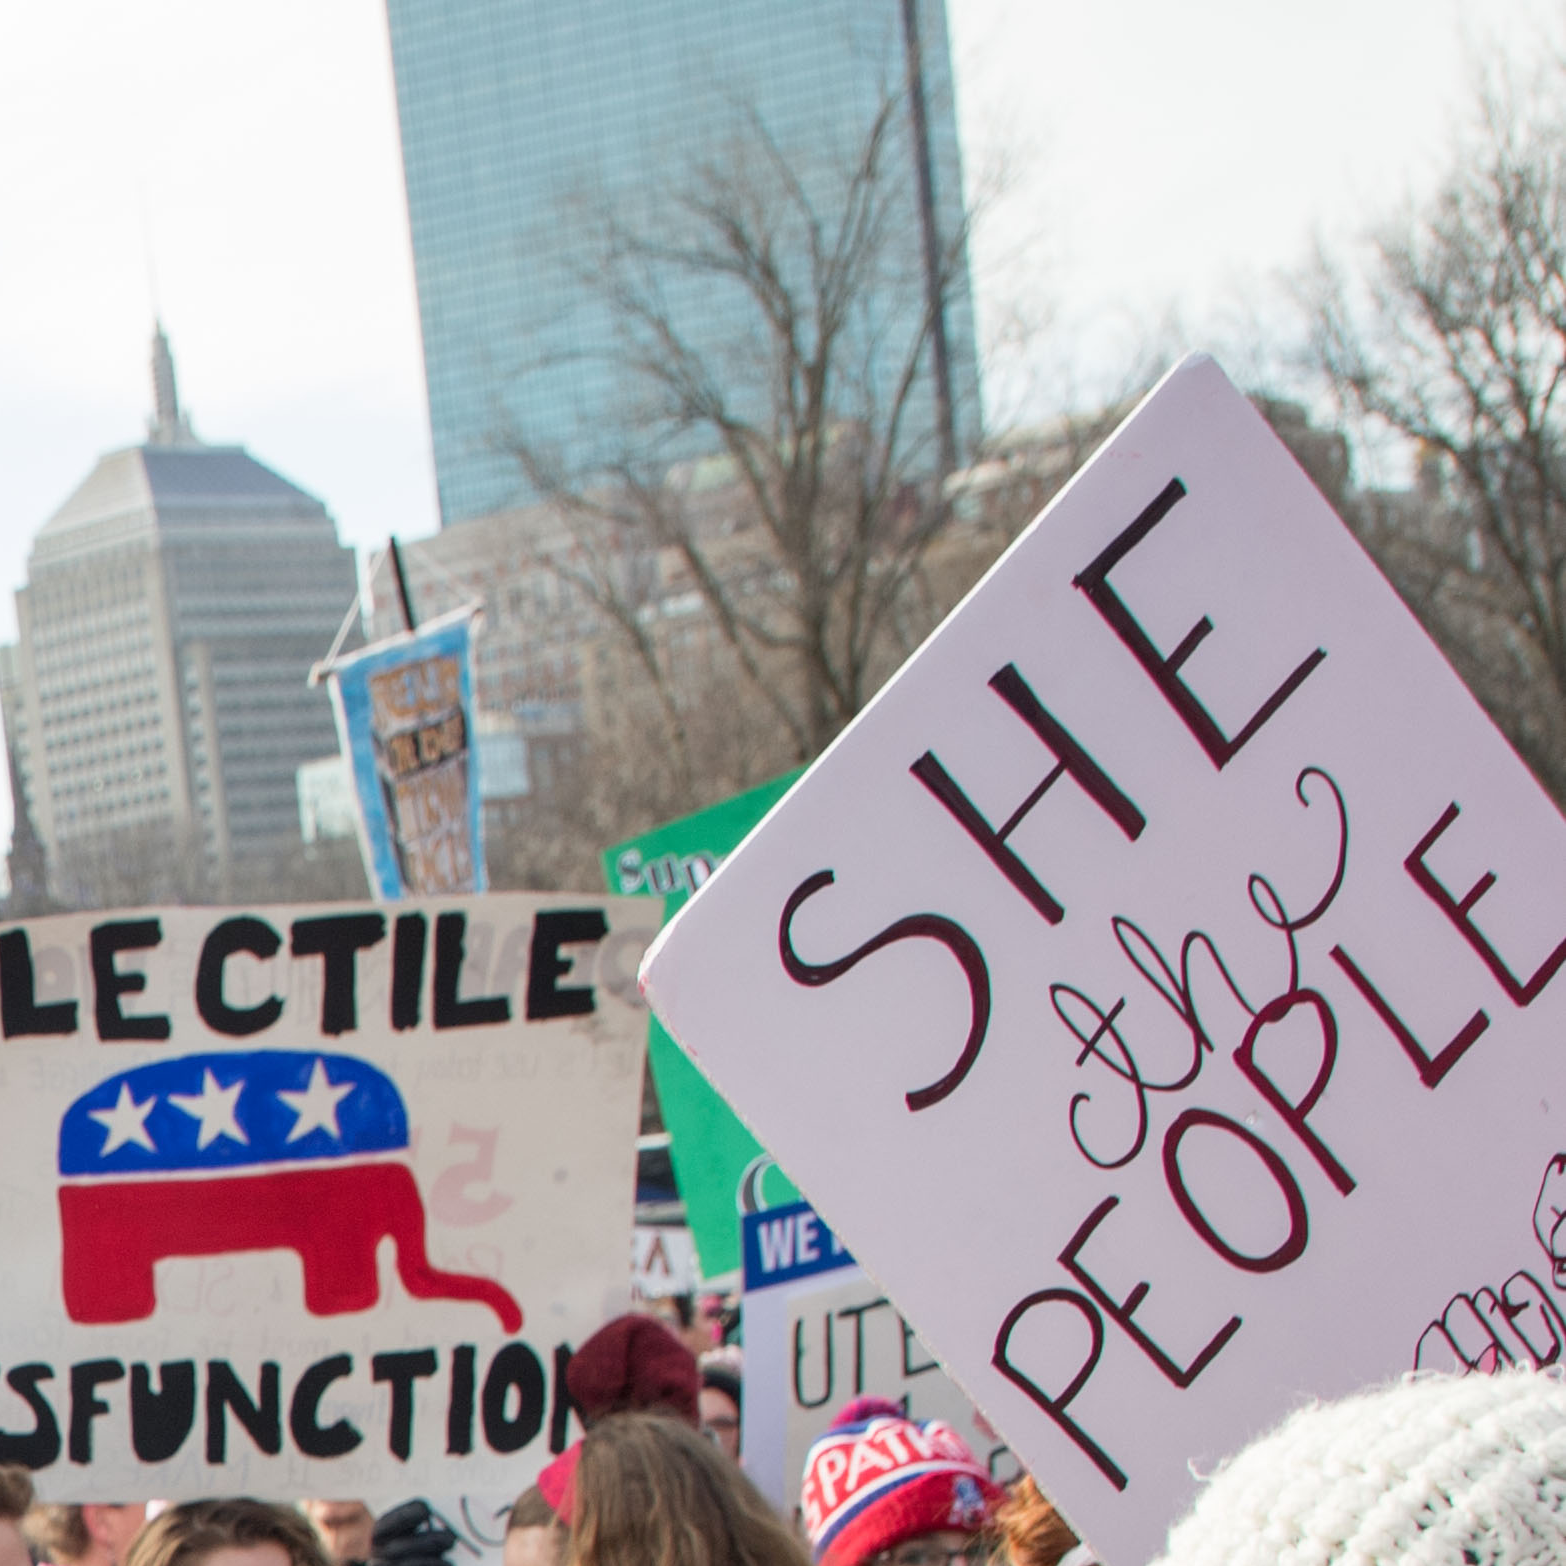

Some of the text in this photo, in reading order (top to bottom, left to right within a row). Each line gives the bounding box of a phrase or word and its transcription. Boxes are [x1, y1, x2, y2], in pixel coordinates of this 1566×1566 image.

[778, 478, 1327, 1112] SHE
[1048, 766, 1349, 1169] the
[756, 1212, 821, 1274] WE
[990, 801, 1566, 1492] PEOPLE
